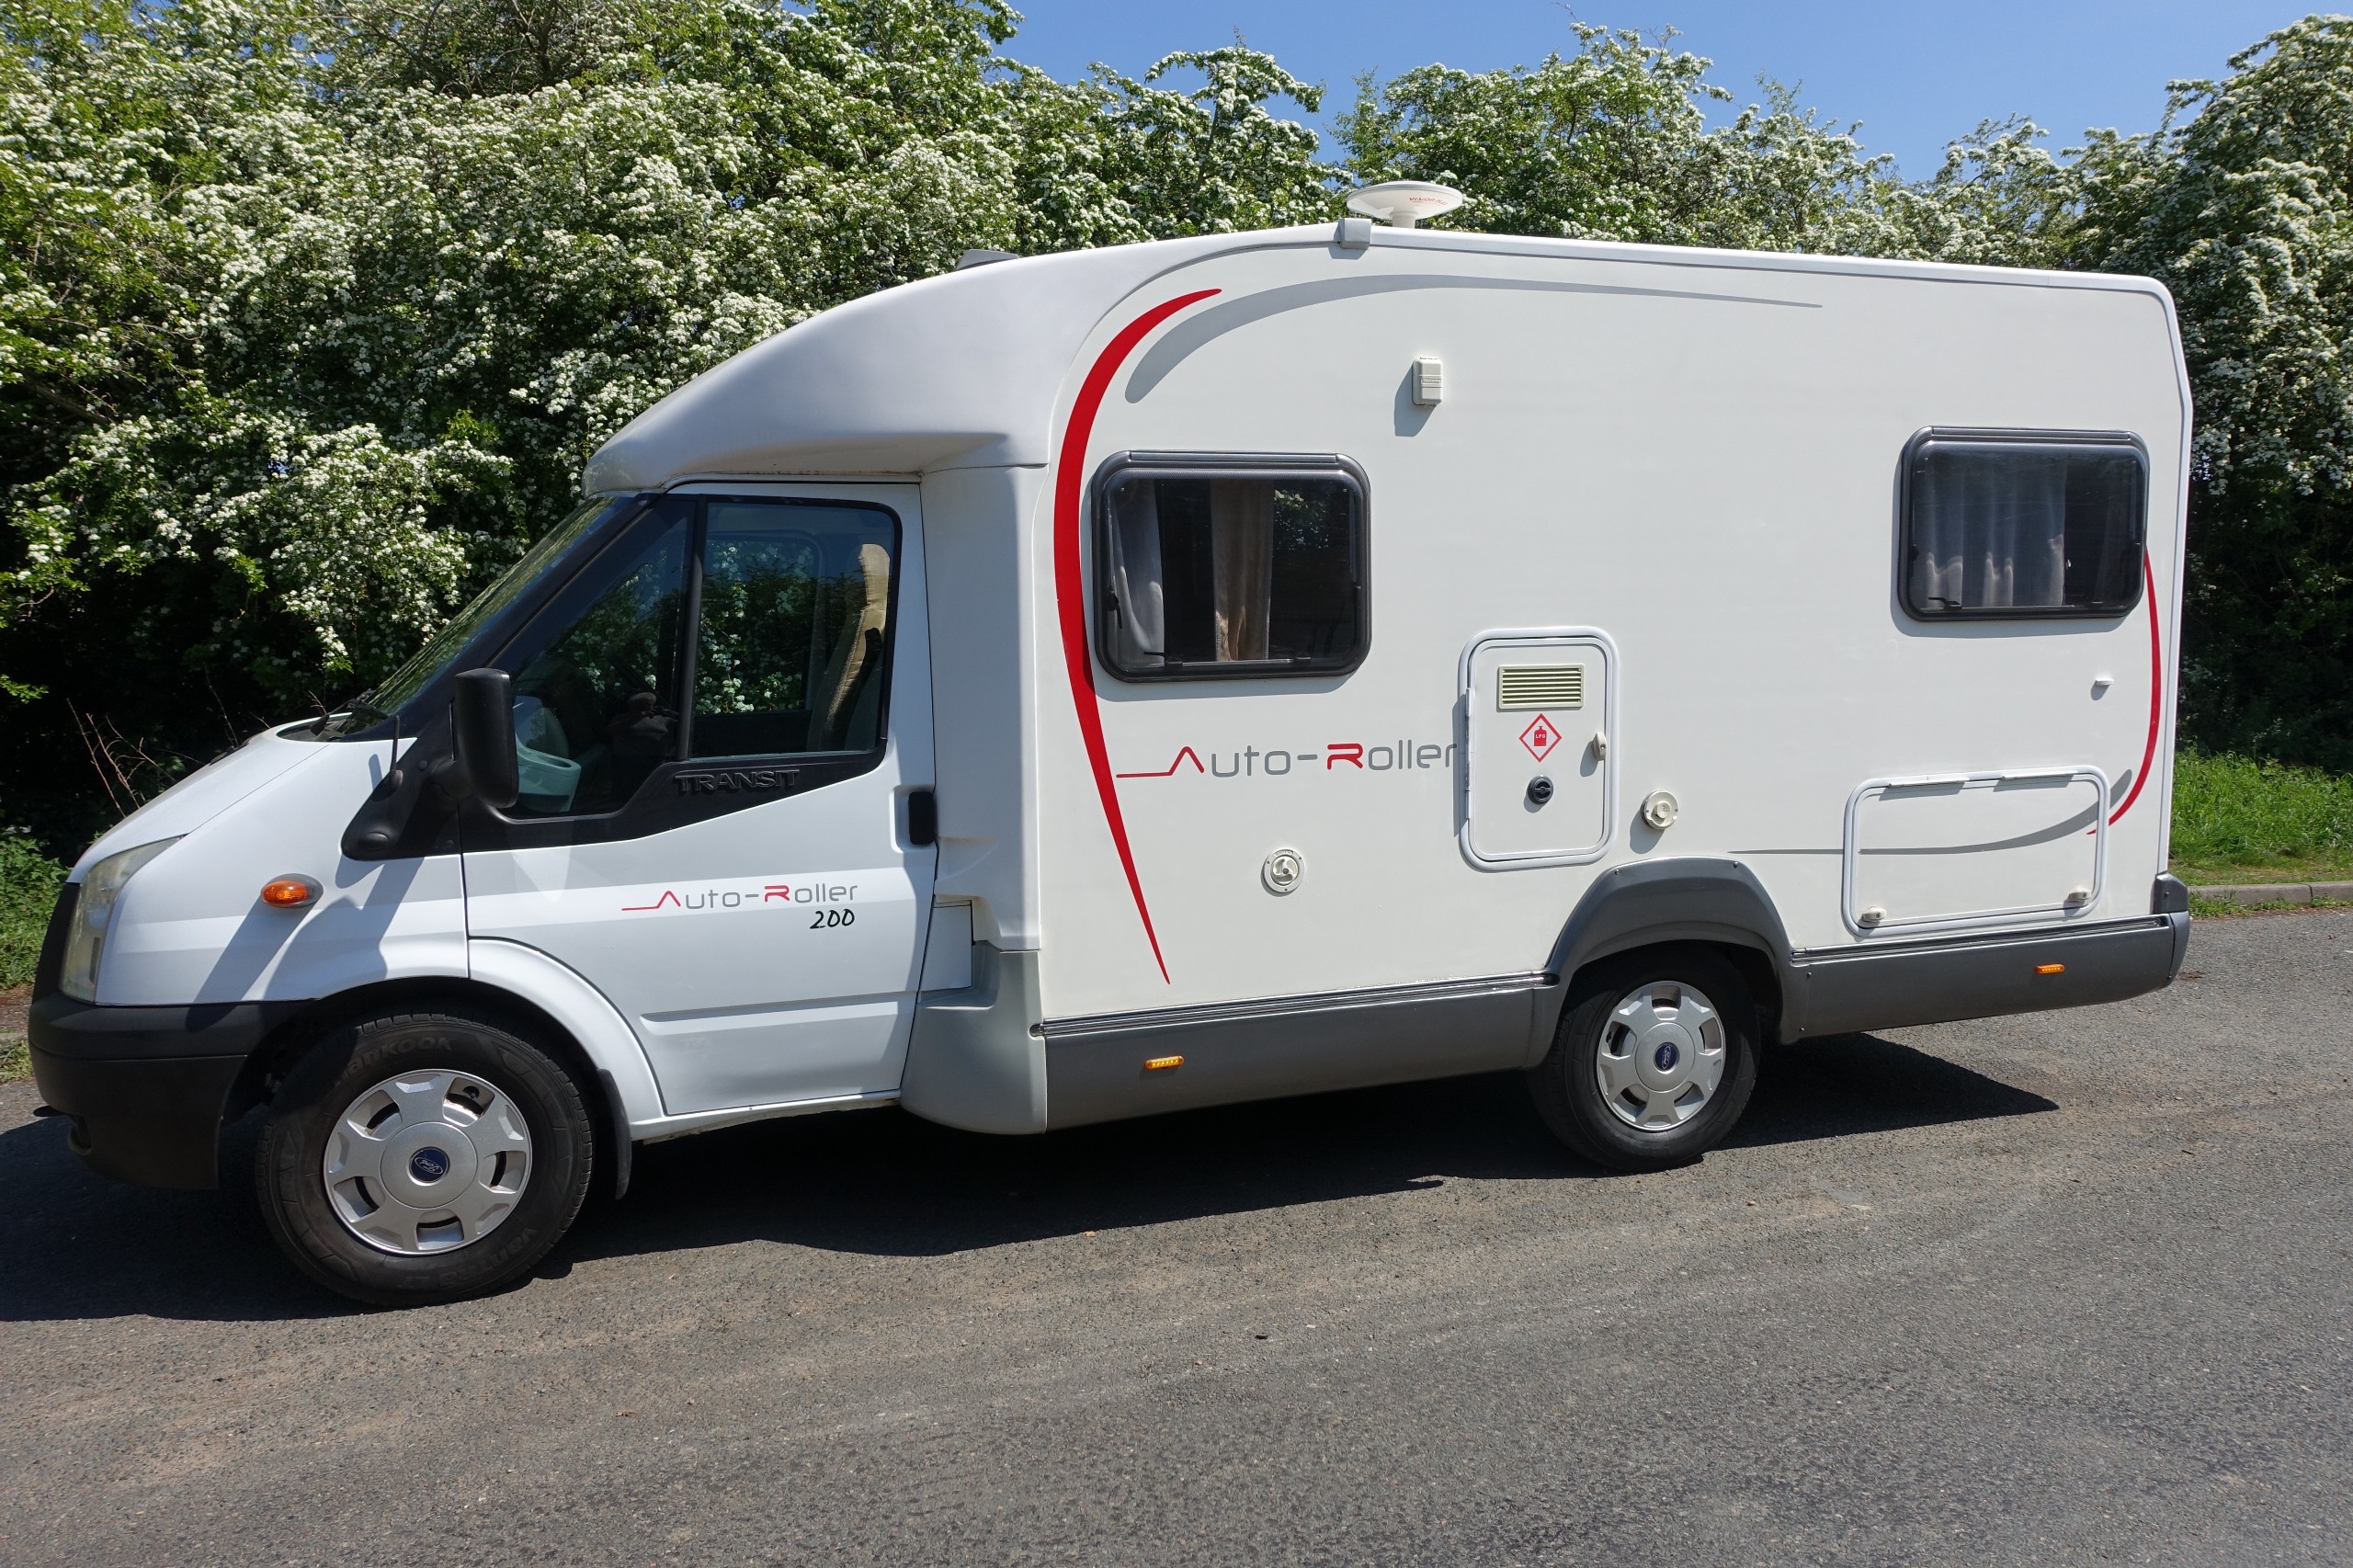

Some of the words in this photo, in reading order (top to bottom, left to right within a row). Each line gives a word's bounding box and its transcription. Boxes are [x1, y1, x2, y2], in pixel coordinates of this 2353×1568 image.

[1116, 739, 1458, 778] Auto-Roller
[675, 768, 800, 795] TRANSIT
[621, 882, 858, 911] Auto-Roller
[809, 908, 856, 930] 200
